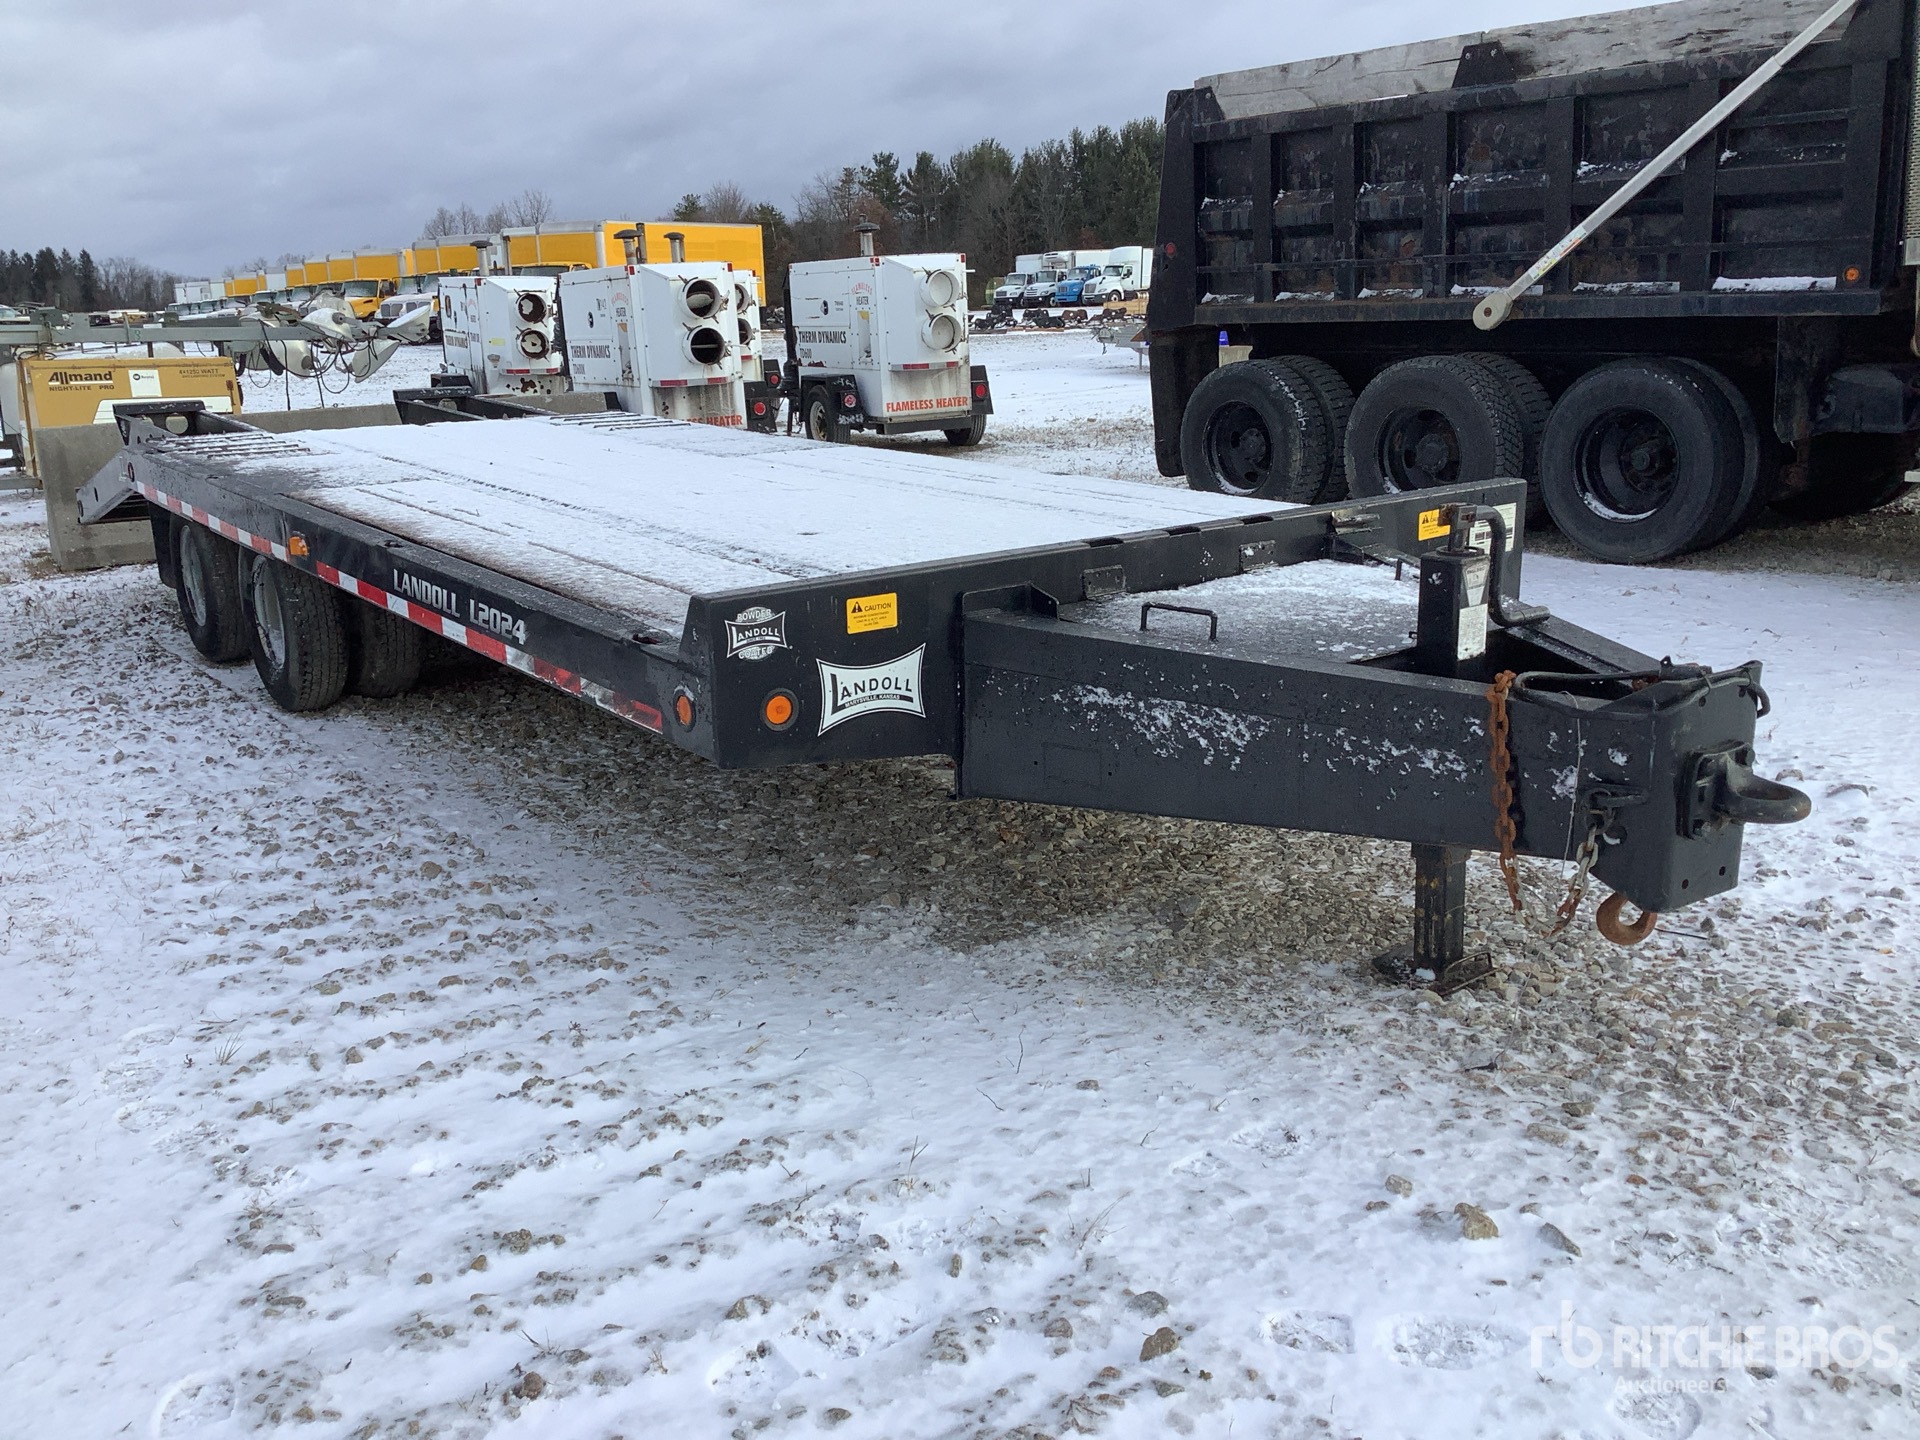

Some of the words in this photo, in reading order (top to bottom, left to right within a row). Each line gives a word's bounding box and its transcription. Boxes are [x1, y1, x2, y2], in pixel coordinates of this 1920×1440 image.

[799, 331, 817, 343] THERM
[817, 331, 847, 344] DYNAMICS
[571, 345, 586, 358] THERM
[586, 345, 611, 358] DYNAMICS
[48, 371, 113, 384] Allmand
[886, 399, 934, 412] FLAMELESS
[936, 396, 968, 408] HEATER
[706, 414, 743, 427] HEATER
[393, 568, 460, 618] LANDOLL
[469, 598, 527, 645] L2024
[864, 602, 892, 612] CAUTION
[731, 626, 781, 649] LANDOLL
[738, 645, 773, 659] COATED
[830, 673, 914, 716] LANDOLL
